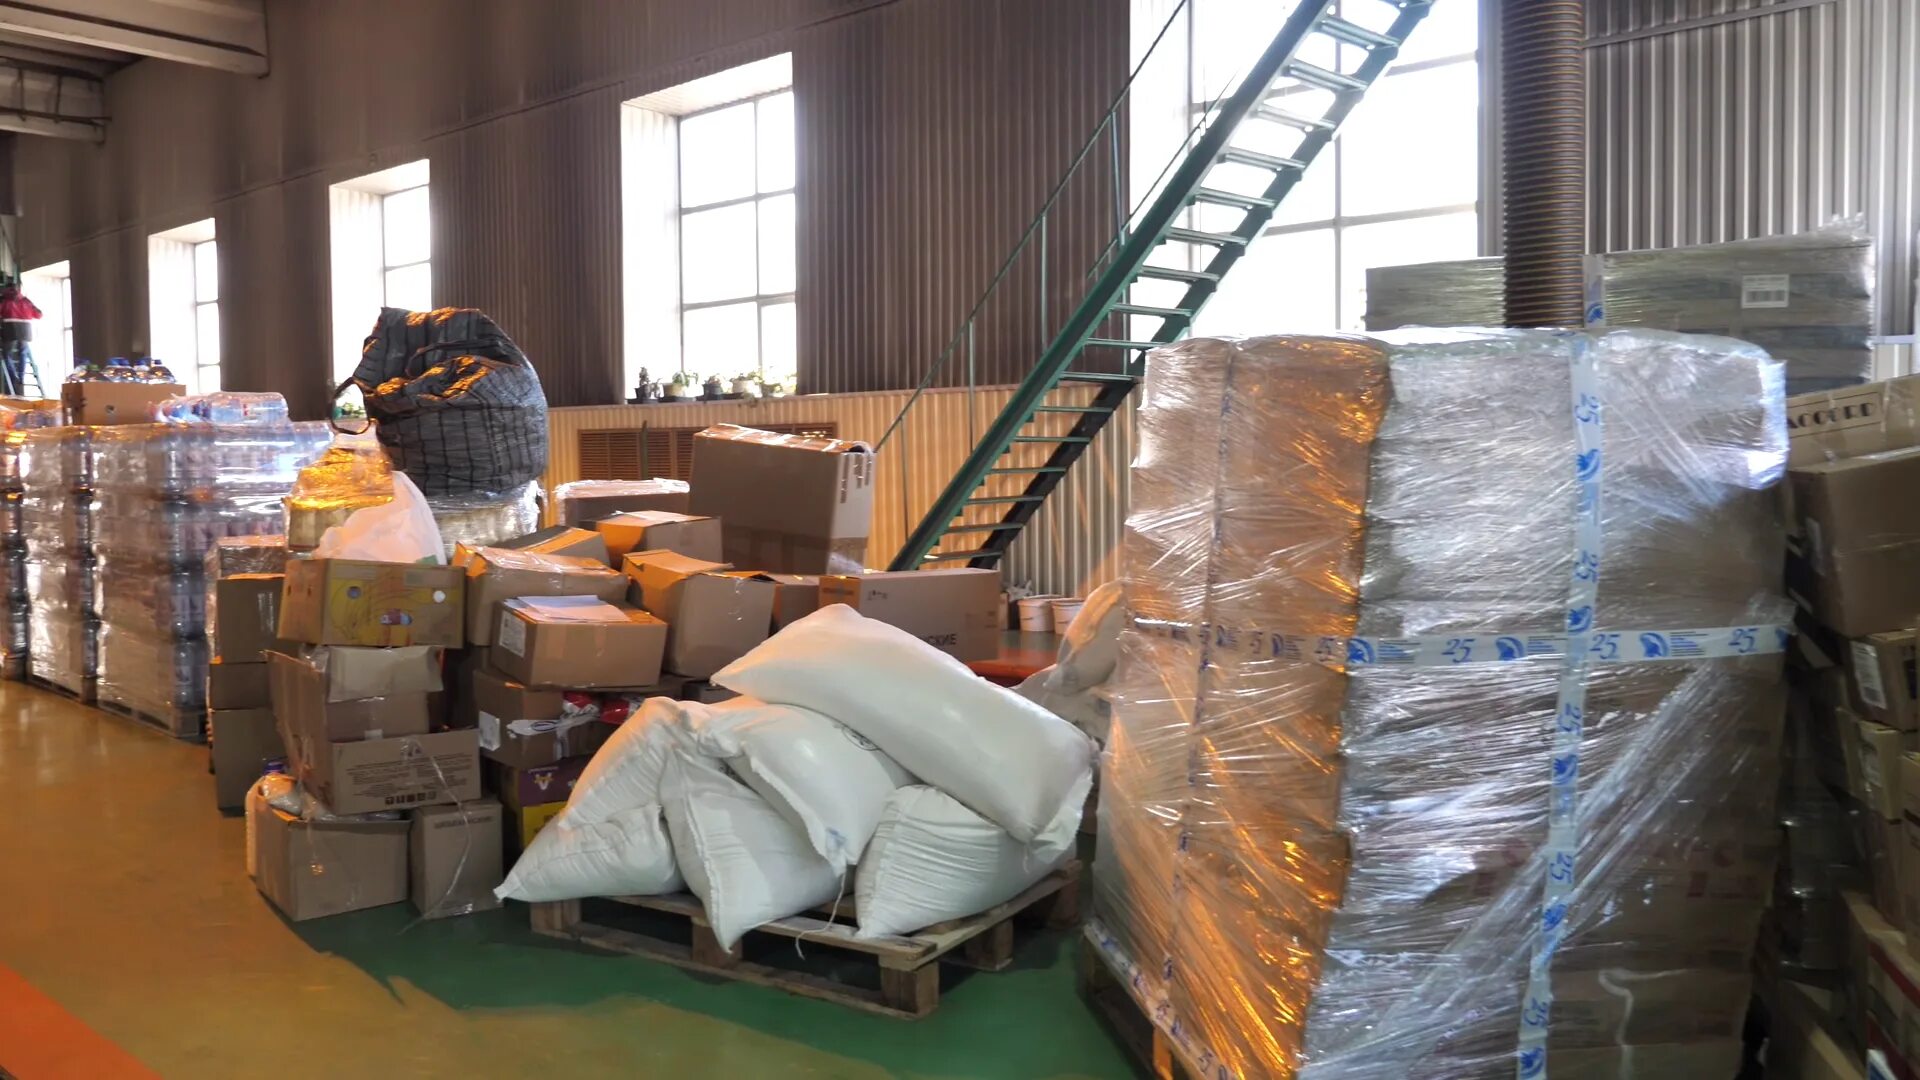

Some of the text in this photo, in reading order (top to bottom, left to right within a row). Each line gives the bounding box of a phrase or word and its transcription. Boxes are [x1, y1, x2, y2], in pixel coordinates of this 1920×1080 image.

[1574, 391, 1600, 425] 25
[1574, 549, 1600, 584] 25
[923, 633, 957, 647] СКИЕ
[1441, 638, 1475, 663] 25
[1589, 633, 1621, 660] 25
[1728, 627, 1760, 653] 25
[1549, 851, 1573, 885] 25
[1523, 997, 1549, 1028] 25
